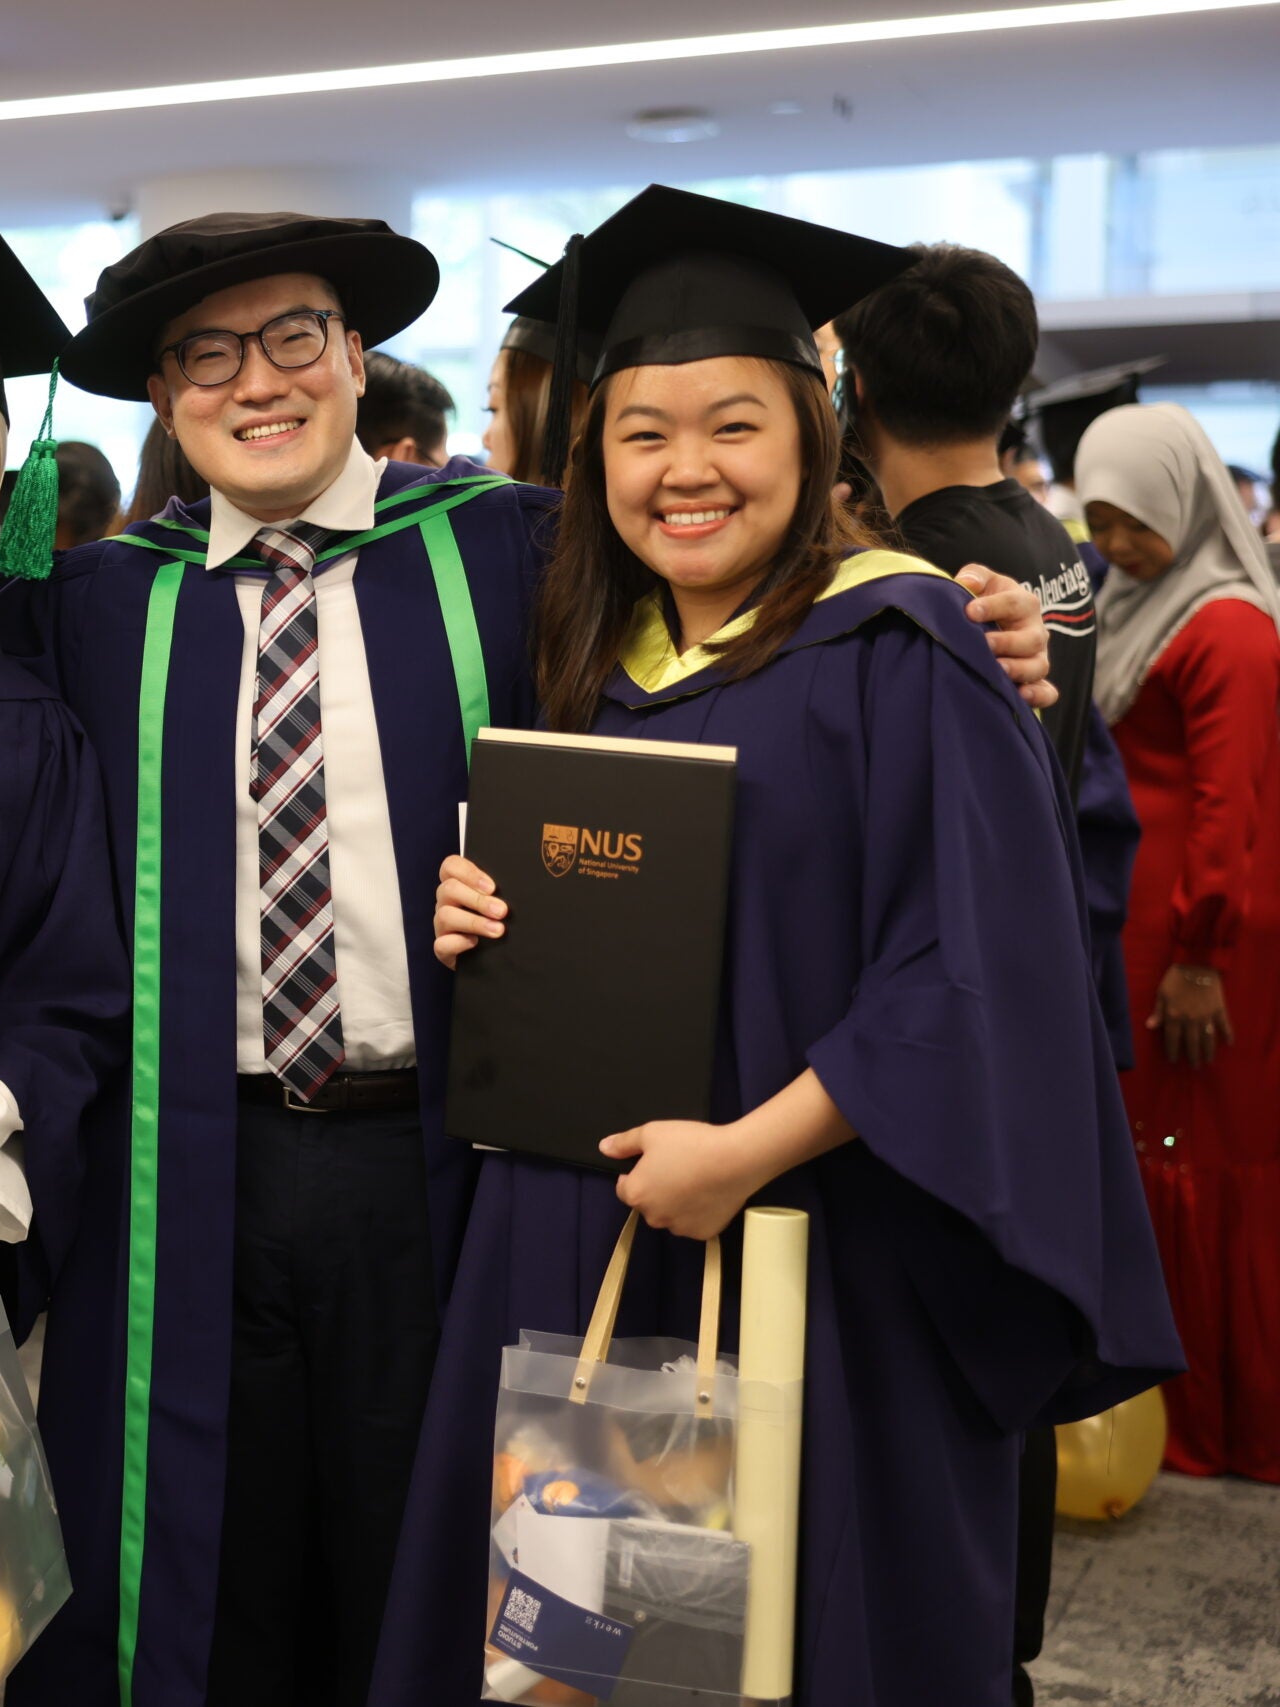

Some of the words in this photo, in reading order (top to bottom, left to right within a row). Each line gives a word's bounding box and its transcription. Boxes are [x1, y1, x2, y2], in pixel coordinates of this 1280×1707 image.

[579, 828, 643, 862] NUS
[578, 857, 607, 868] National
[607, 861, 639, 874] University
[586, 867, 619, 879] Singapore
[497, 1630, 522, 1649] STUDIO
[499, 1623, 539, 1652] PORTRAITURE
